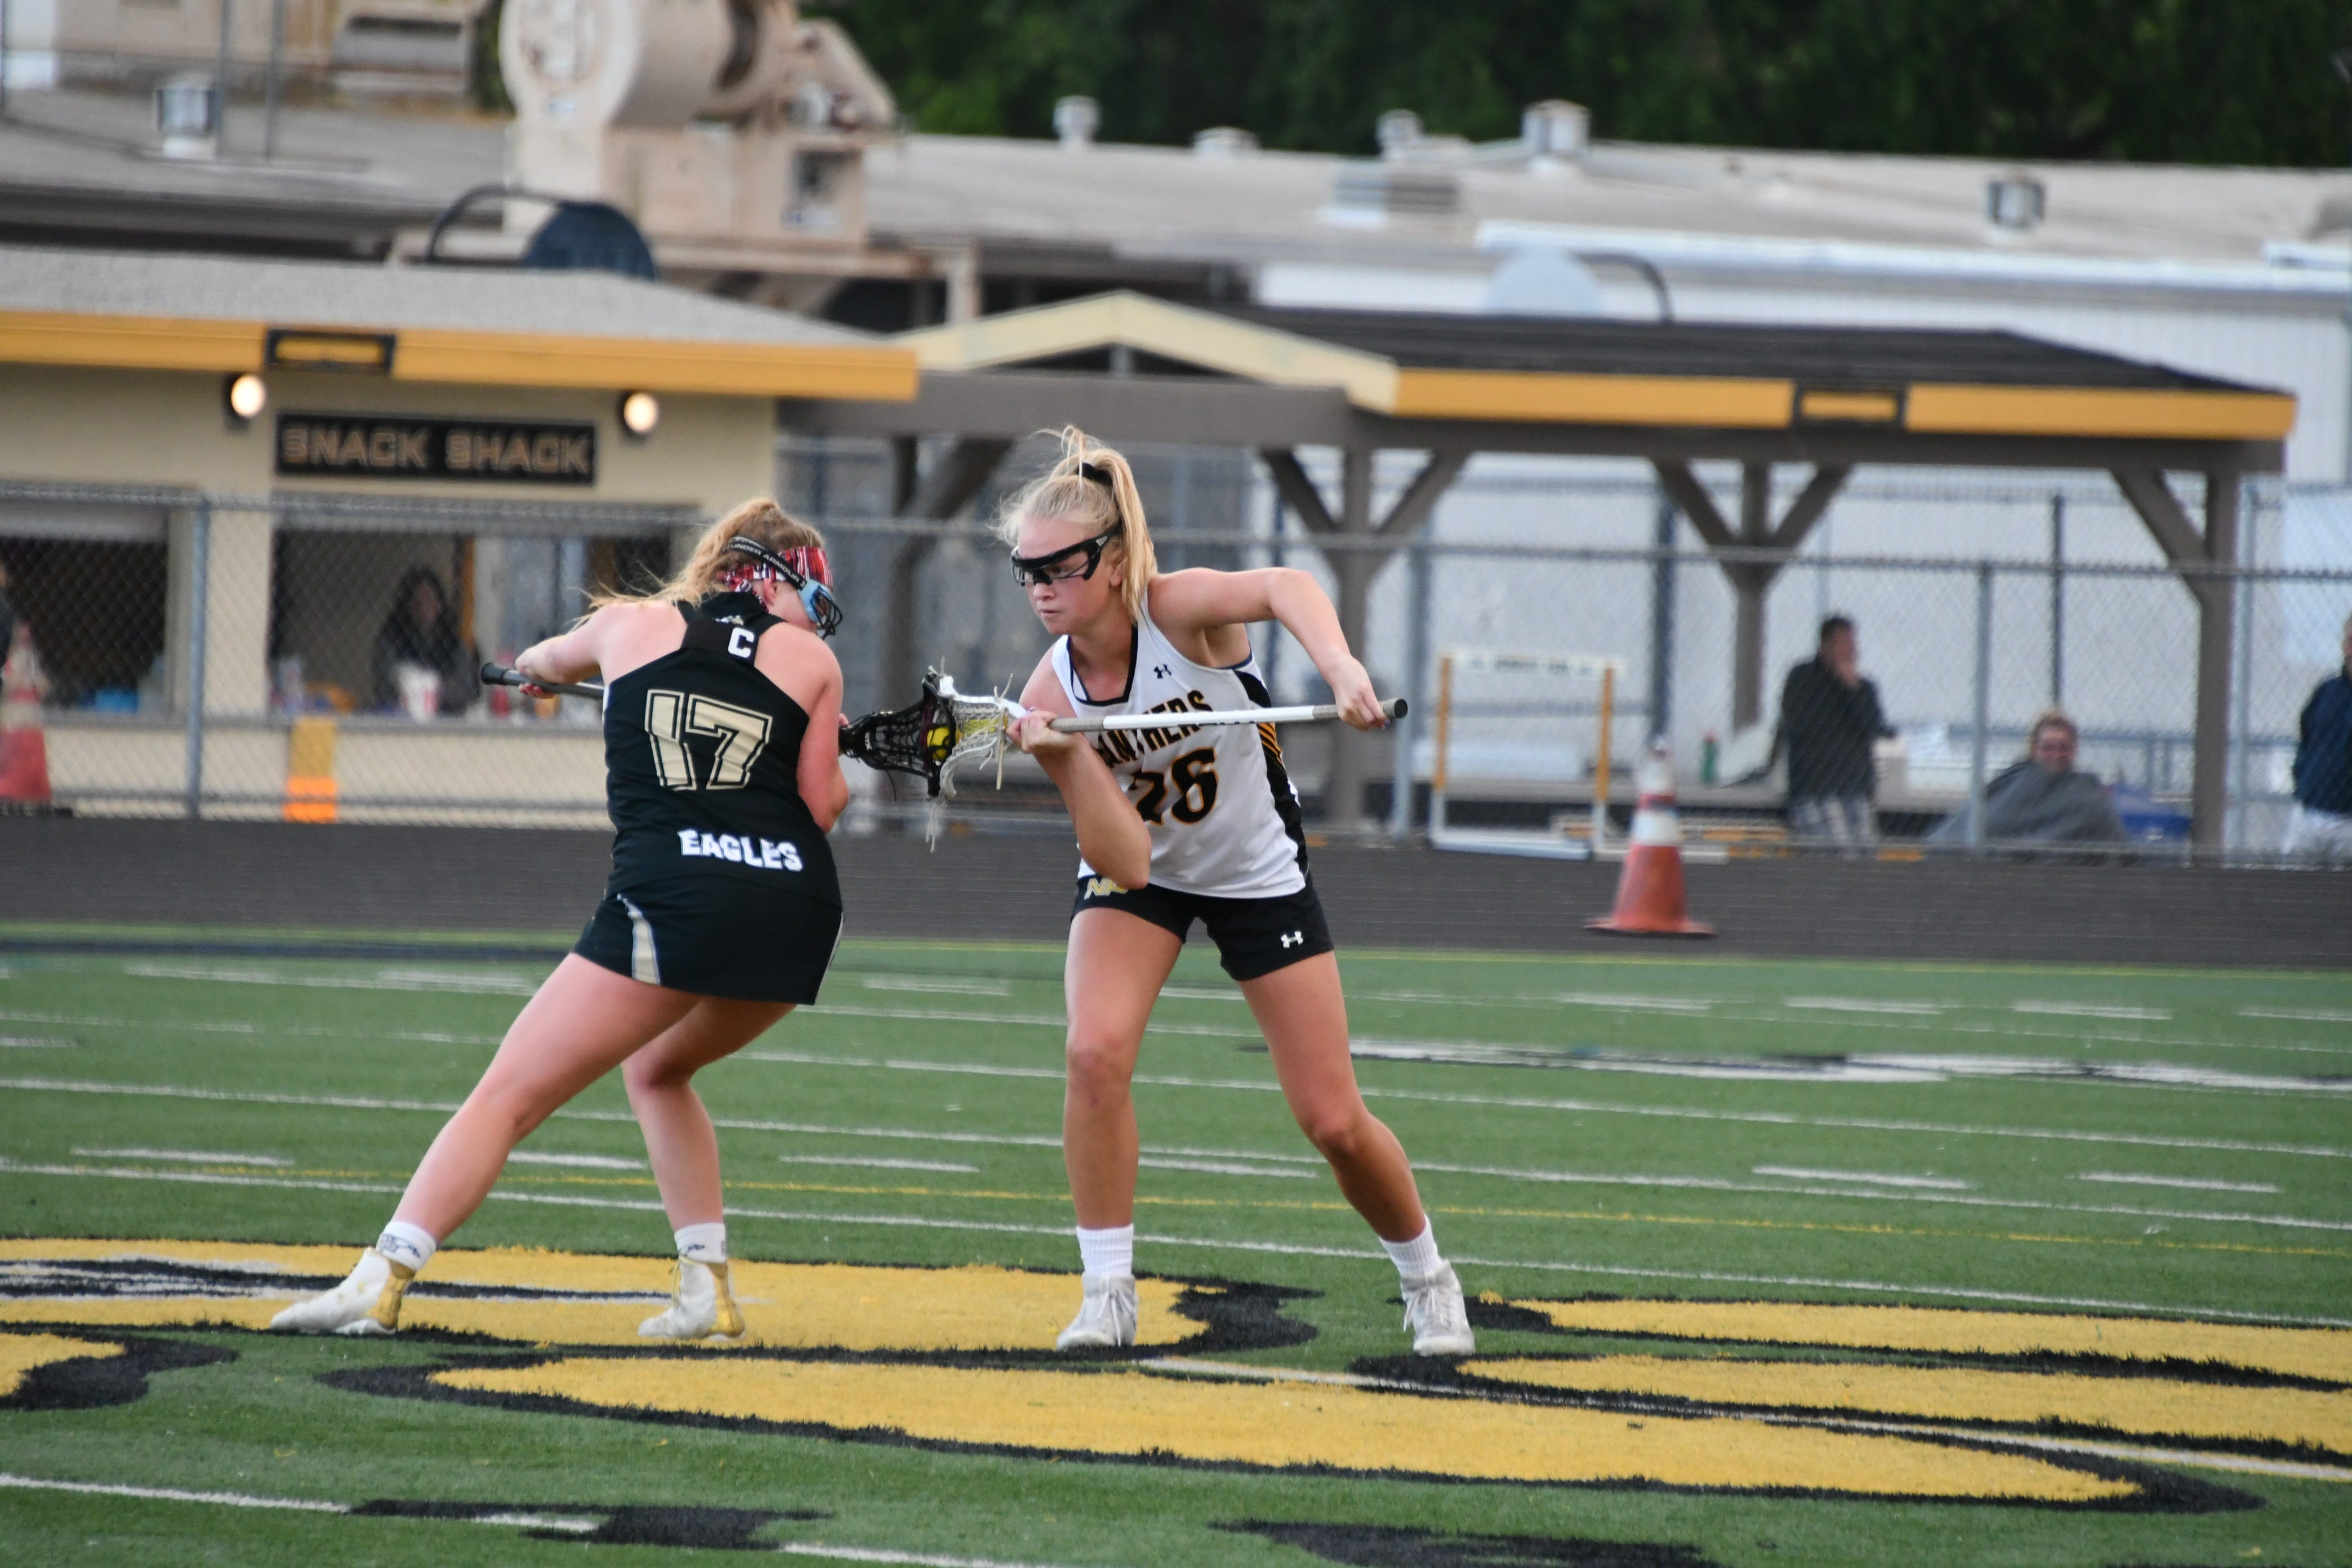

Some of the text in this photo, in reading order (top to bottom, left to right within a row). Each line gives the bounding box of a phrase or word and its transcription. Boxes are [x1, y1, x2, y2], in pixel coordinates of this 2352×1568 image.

[284, 426, 591, 474] SNACK SHACK
[730, 544, 800, 582] UNDER ARMOUR
[728, 627, 754, 658] C
[644, 689, 772, 790] 17
[1092, 690, 1213, 768] ANTHERS
[1128, 747, 1219, 826] 26
[678, 829, 804, 872] EAGLES
